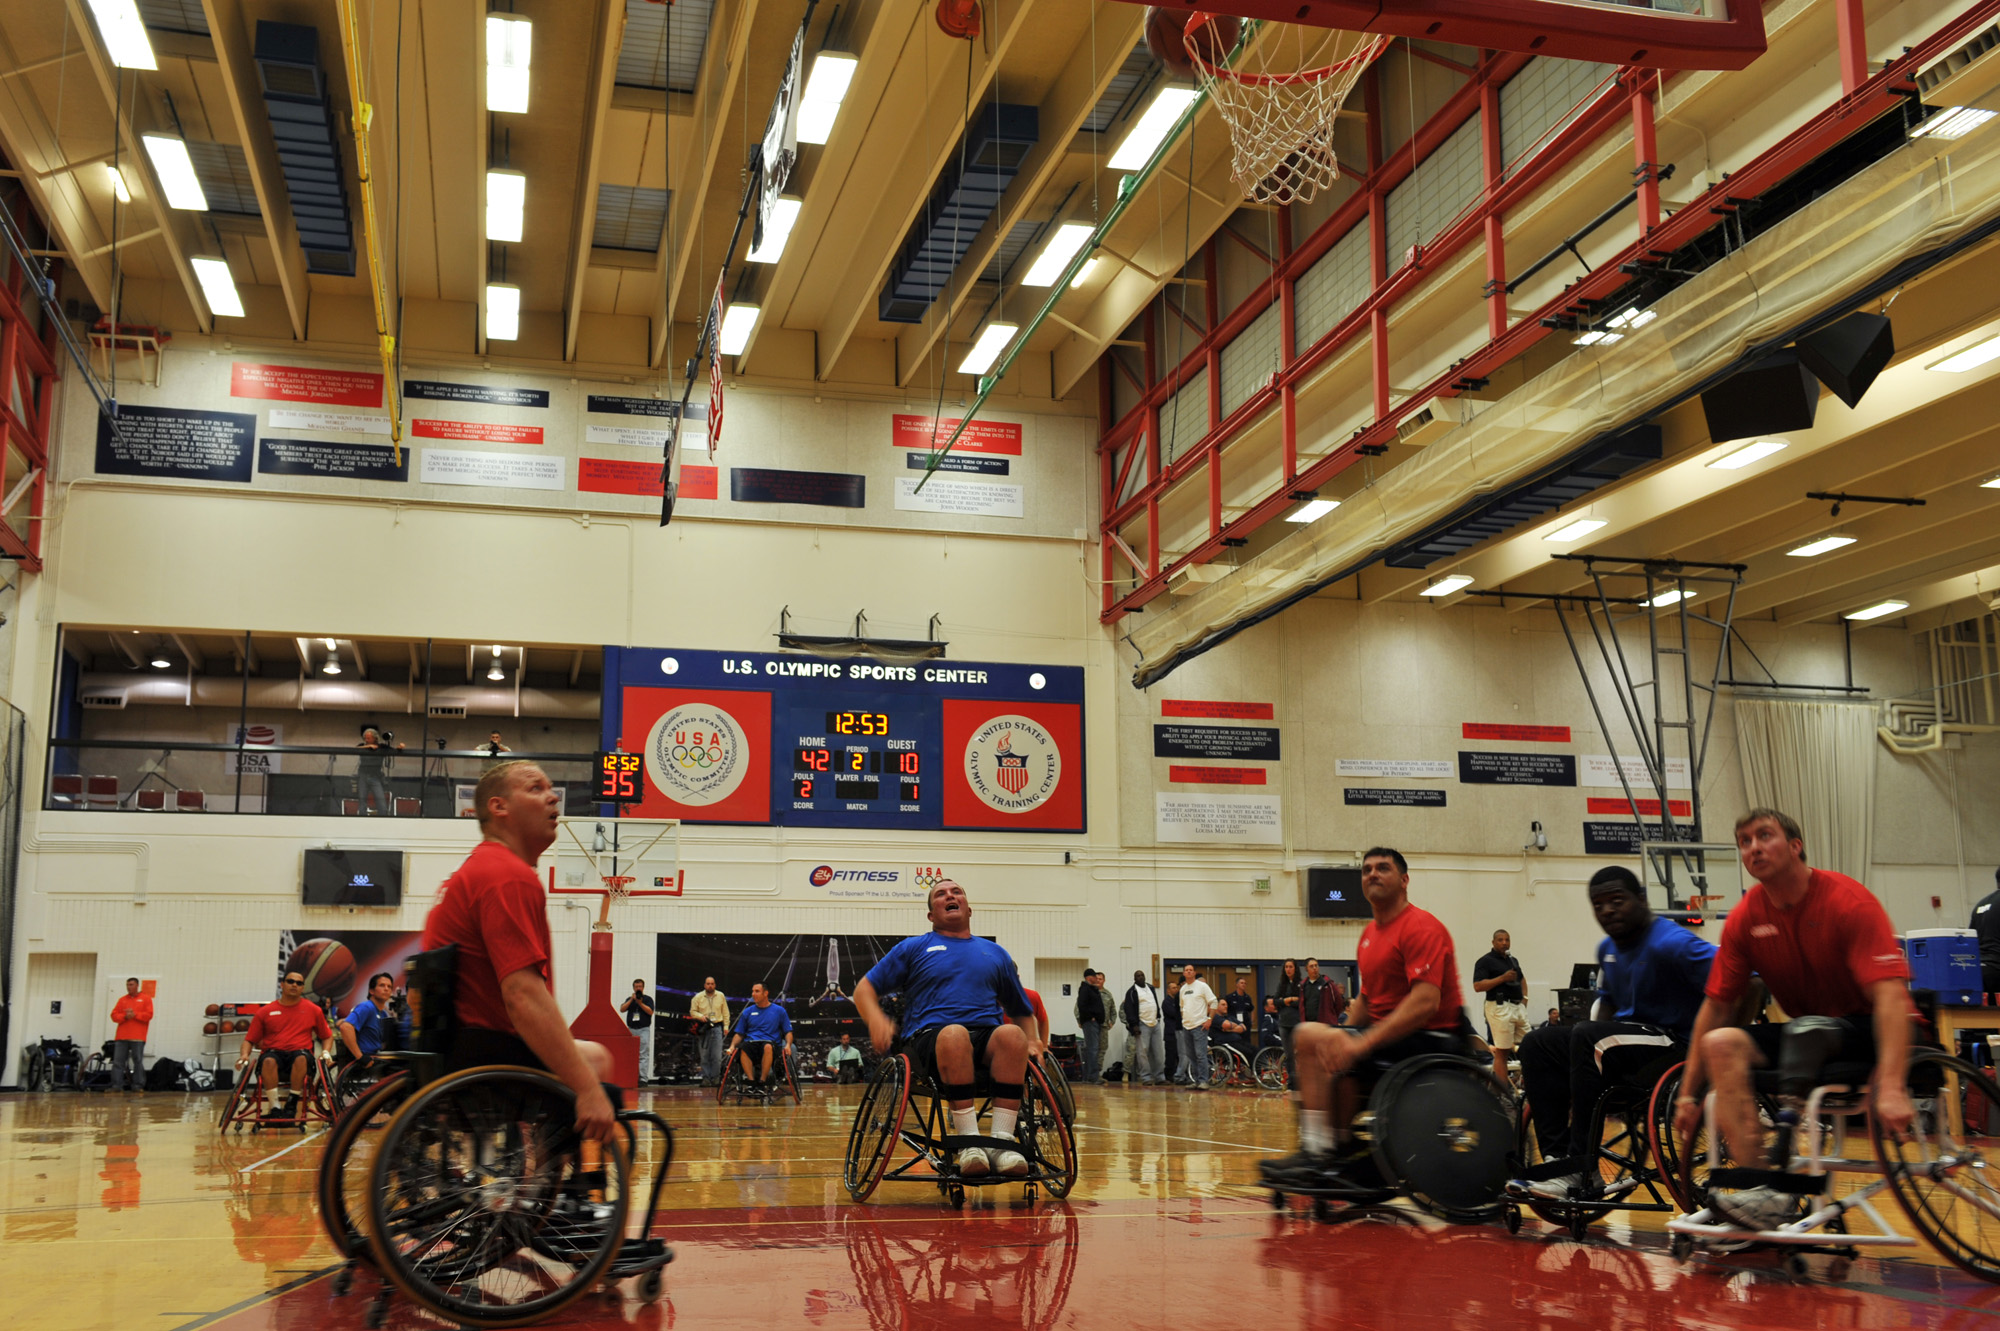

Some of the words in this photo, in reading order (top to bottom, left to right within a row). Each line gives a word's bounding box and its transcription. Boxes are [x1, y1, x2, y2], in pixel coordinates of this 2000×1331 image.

[309, 446, 332, 454] BECOME
[362, 455, 386, 463] ENOUGH
[329, 465, 354, 473] JACKSON
[723, 659, 757, 674] U.S.
[765, 661, 841, 678] OLYMPIC
[849, 665, 916, 681] SPORTS
[924, 668, 988, 684] CENTER
[668, 717, 697, 738] UNITED
[699, 717, 726, 739] STATES
[836, 713, 888, 735] 12:53
[978, 721, 1012, 743] UNITED
[1014, 721, 1047, 745] STATES
[799, 736, 826, 747] HOME
[846, 745, 869, 753] PERIOD
[887, 739, 917, 750] GUEST
[235, 755, 271, 766] USA
[603, 755, 640, 771] 12:52
[664, 746, 688, 780] OLYMPIC
[690, 749, 730, 782] COMMITTEE
[802, 750, 829, 771] 42
[851, 753, 863, 770] 2
[900, 752, 919, 774] 10
[602, 770, 635, 796] 35
[970, 751, 990, 796] OLYMPIC
[991, 793, 1041, 808] TRAINING
[1040, 753, 1055, 794] CENTER
[800, 780, 812, 798] 2
[913, 785, 918, 799] 1
[815, 869, 831, 880] 24
[832, 870, 899, 881] FITNESS
[916, 867, 942, 876] USA
